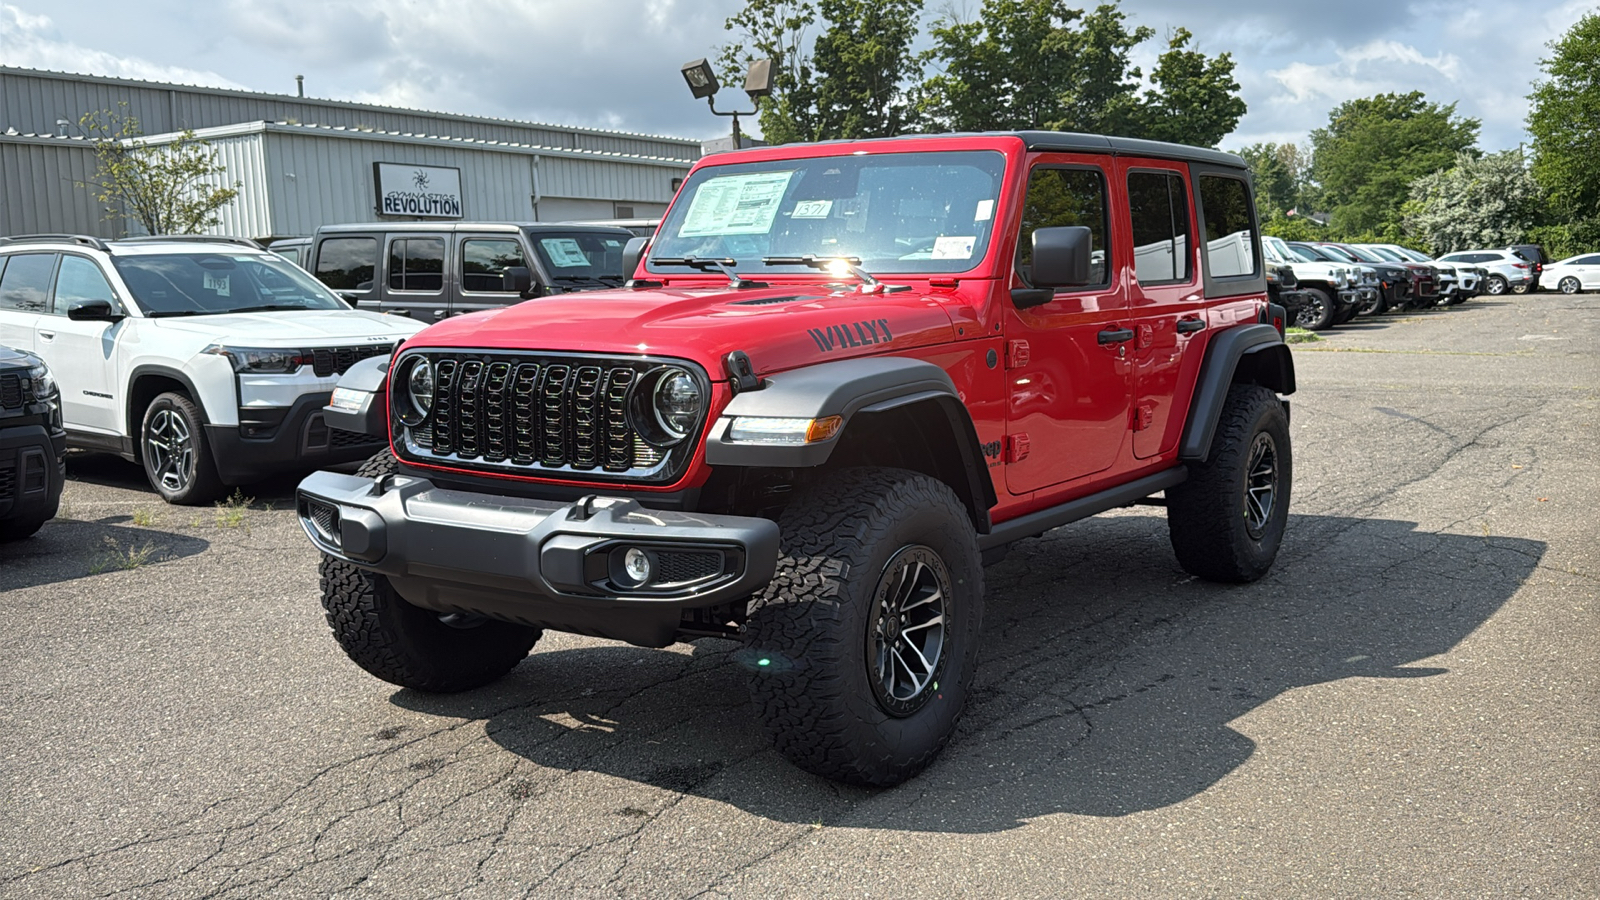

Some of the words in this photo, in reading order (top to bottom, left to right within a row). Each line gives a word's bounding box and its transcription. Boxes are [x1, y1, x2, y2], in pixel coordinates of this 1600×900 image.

[387, 191, 455, 201] GYMNASTICS
[384, 197, 460, 215] REVOLUTION
[806, 318, 893, 352] WILLYS
[980, 440, 1002, 459] eep
